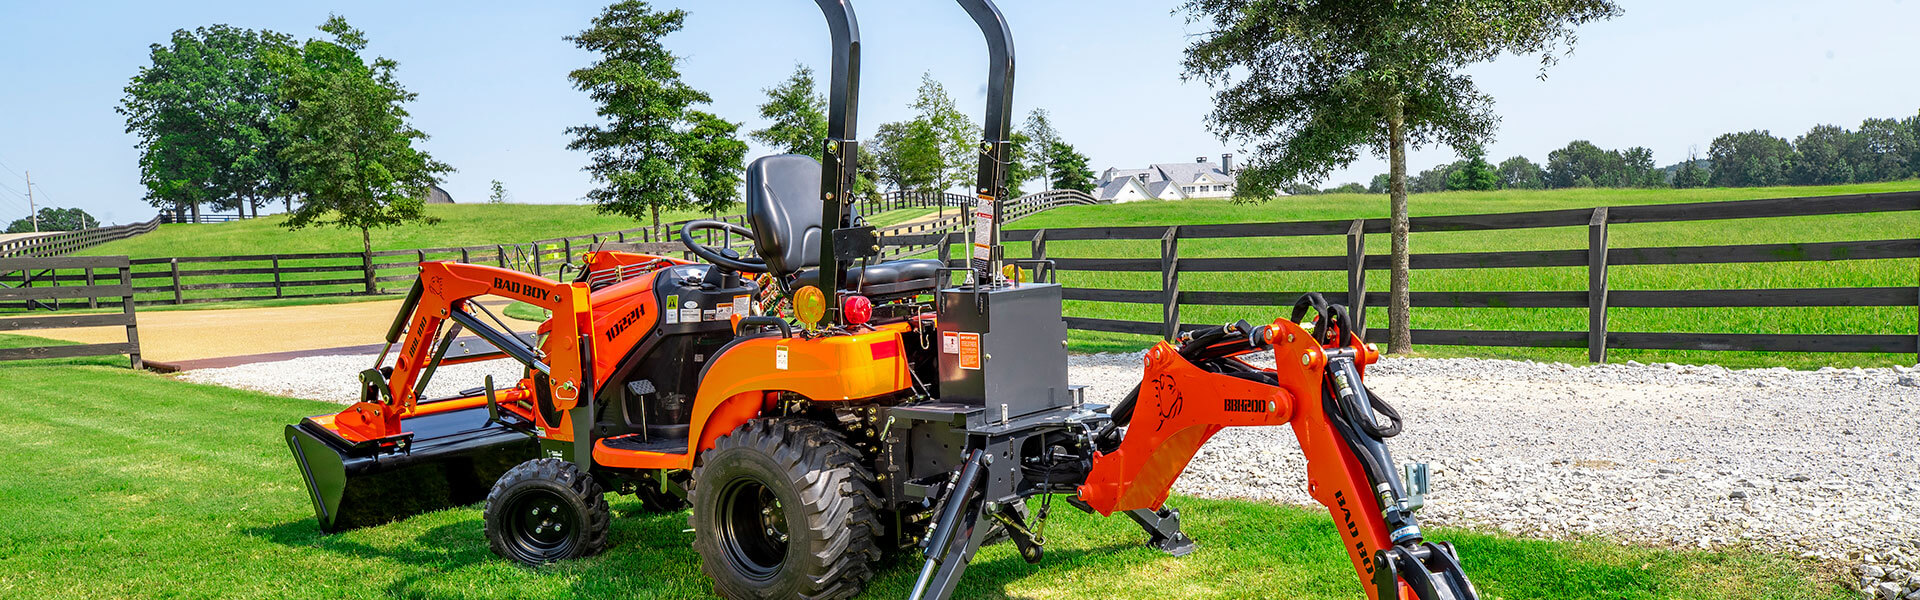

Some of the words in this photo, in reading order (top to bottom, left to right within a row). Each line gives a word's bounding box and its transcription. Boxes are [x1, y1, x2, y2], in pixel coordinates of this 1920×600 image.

[493, 277, 520, 293] BAD
[523, 284, 551, 301] BOY
[605, 303, 645, 342] 1022H
[1224, 399, 1266, 412] BBH200
[1335, 490, 1359, 538] BAD
[1356, 541, 1376, 585] BO
